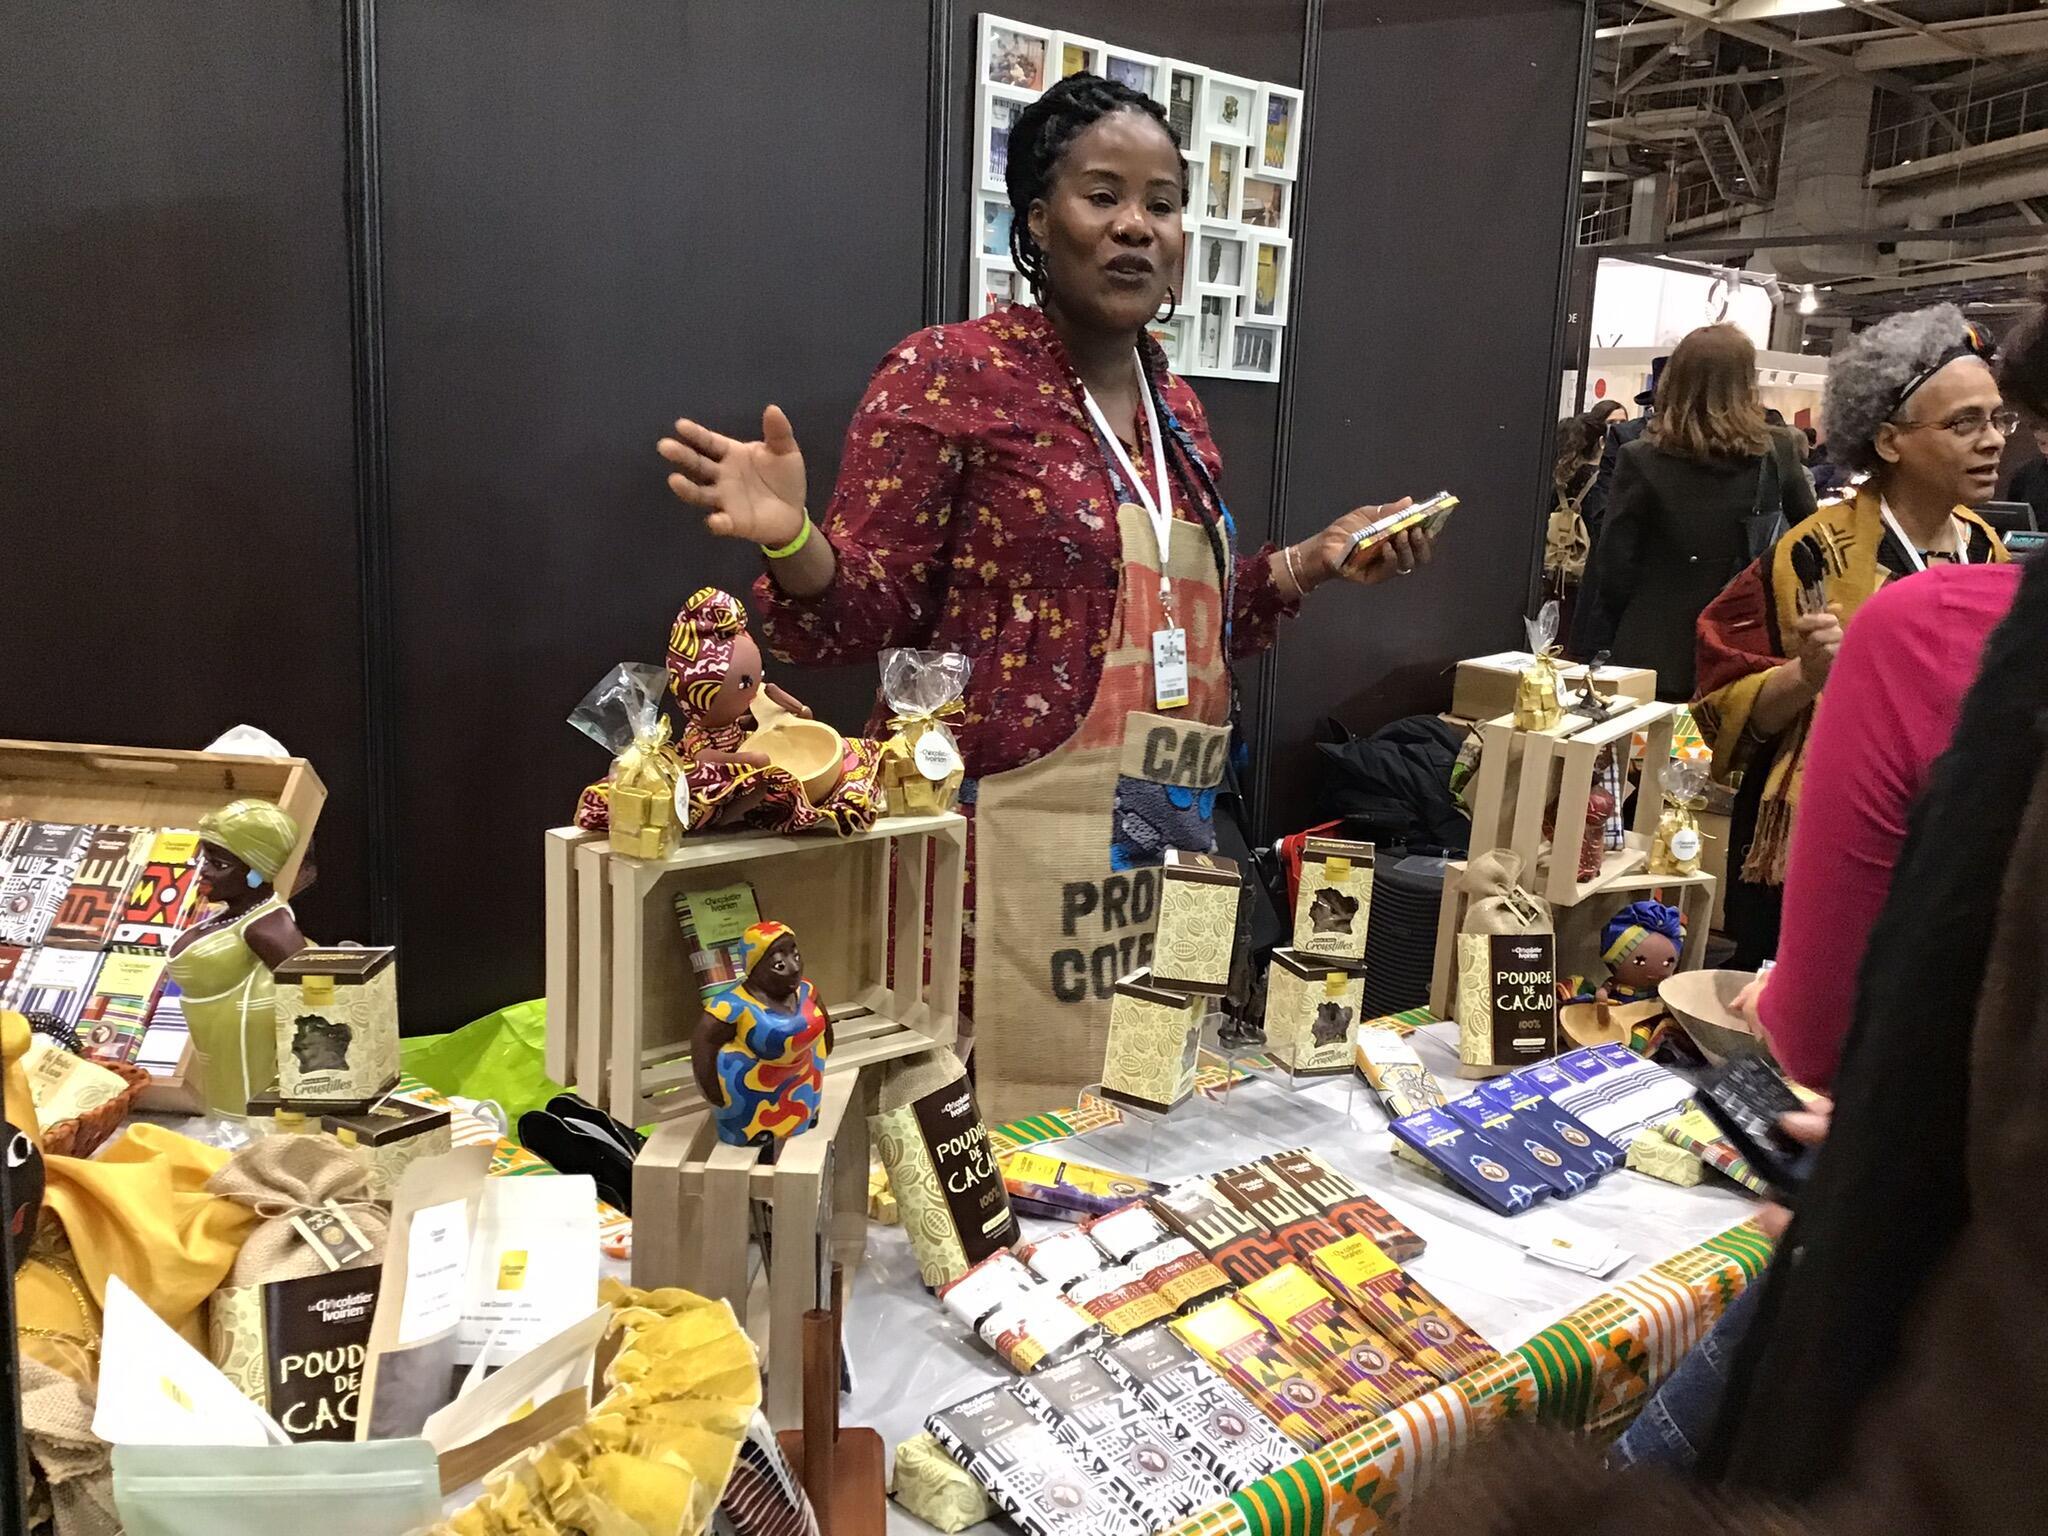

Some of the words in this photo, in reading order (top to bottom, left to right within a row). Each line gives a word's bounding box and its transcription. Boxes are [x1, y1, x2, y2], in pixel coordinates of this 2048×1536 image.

[1305, 939, 1353, 951] Croustilles
[1497, 971, 1552, 985] POUDRE
[1523, 985, 1536, 995] DE
[1497, 994, 1553, 1011] CACAO
[1518, 1020, 1541, 1029] 100%
[293, 1079, 352, 1095] Croustilles
[969, 1145, 982, 1161] DE
[316, 1292, 373, 1311] Chocolatier
[323, 1306, 364, 1322] Ivoirien
[334, 1372, 361, 1393] DE
